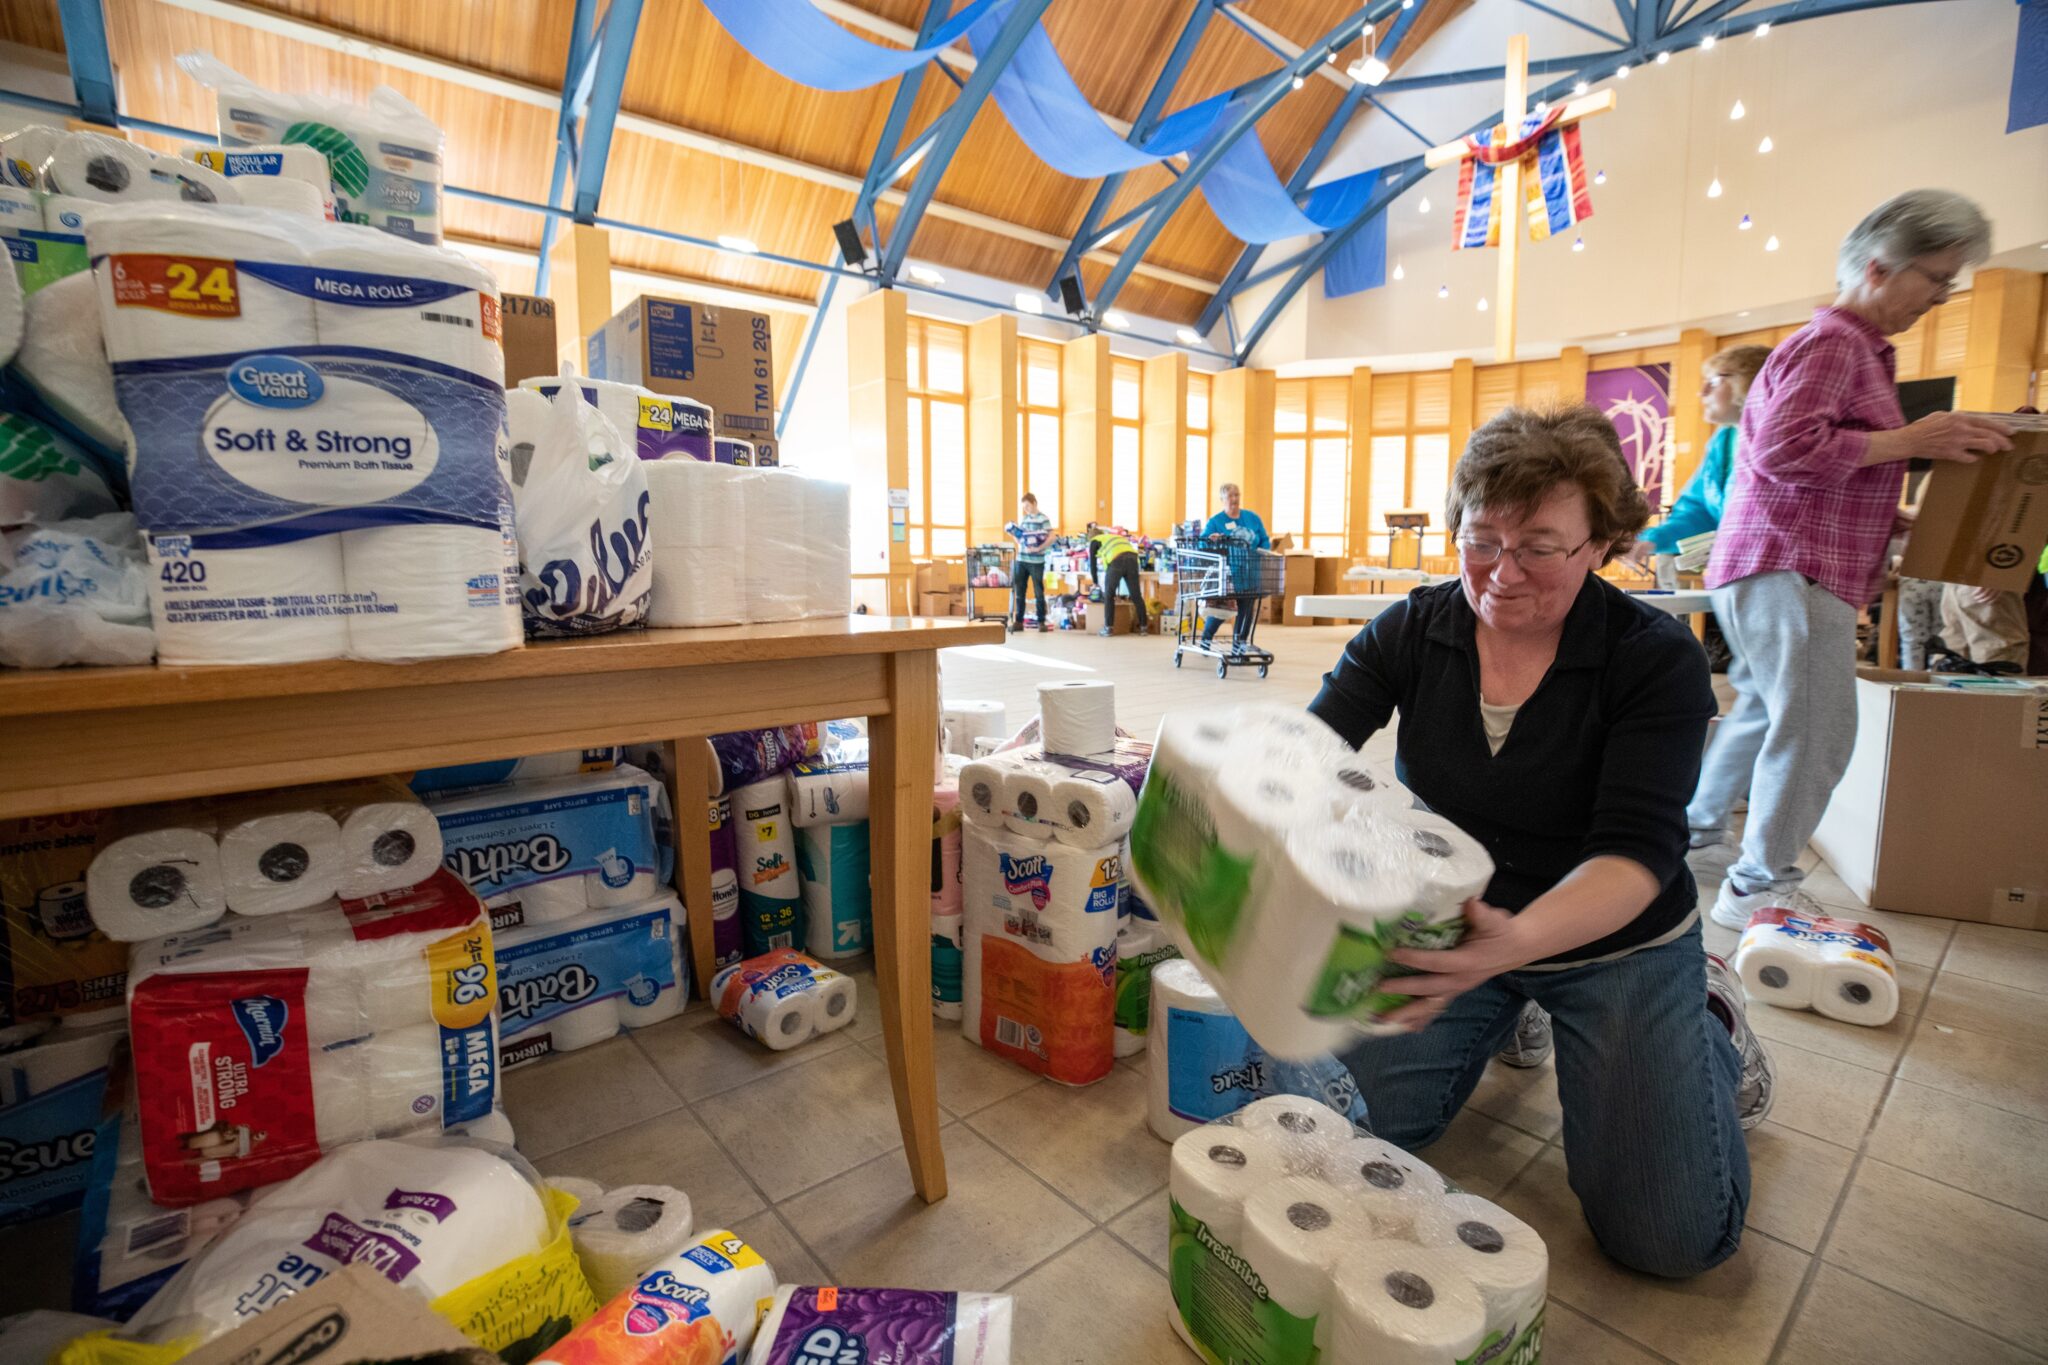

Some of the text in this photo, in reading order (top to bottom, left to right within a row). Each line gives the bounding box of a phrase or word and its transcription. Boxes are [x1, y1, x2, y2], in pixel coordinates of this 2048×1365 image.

[228, 154, 278, 166] REGULAR
[230, 164, 264, 175] ROLLS
[115, 261, 127, 280] 6
[166, 263, 236, 304] 24
[314, 276, 414, 299] MEGA ROLLS
[238, 366, 308, 388] Great
[753, 357, 769, 379] 61
[257, 382, 309, 400] Value
[754, 384, 769, 412] TM
[649, 405, 671, 424] 24
[673, 411, 704, 429] MEGA
[214, 427, 412, 460] Soft & Strong
[298, 459, 414, 471] Premium Bath Tissue
[160, 560, 207, 583] 420
[477, 578, 499, 589] USA
[474, 834, 571, 883] Bath
[756, 852, 784, 872] Soft
[1007, 856, 1119, 881] Scott 12
[1093, 891, 1107, 900] BIG
[1093, 896, 1115, 908] ROLLS
[2008, 892, 2025, 904] E
[83, 972, 128, 990] SHEE
[453, 963, 488, 1005] 96
[764, 965, 801, 991] Scott
[500, 964, 597, 1018] Bath
[242, 999, 276, 1047] harmin
[466, 1030, 490, 1096] MEGA
[215, 1056, 236, 1109] STRONG
[232, 1061, 248, 1097] ULTRA
[424, 1196, 440, 1208] 12
[383, 1221, 422, 1247] Bathroom
[720, 1239, 744, 1256] 4
[1196, 1222, 1268, 1300] Irresistible
[643, 1274, 710, 1306] Scott
